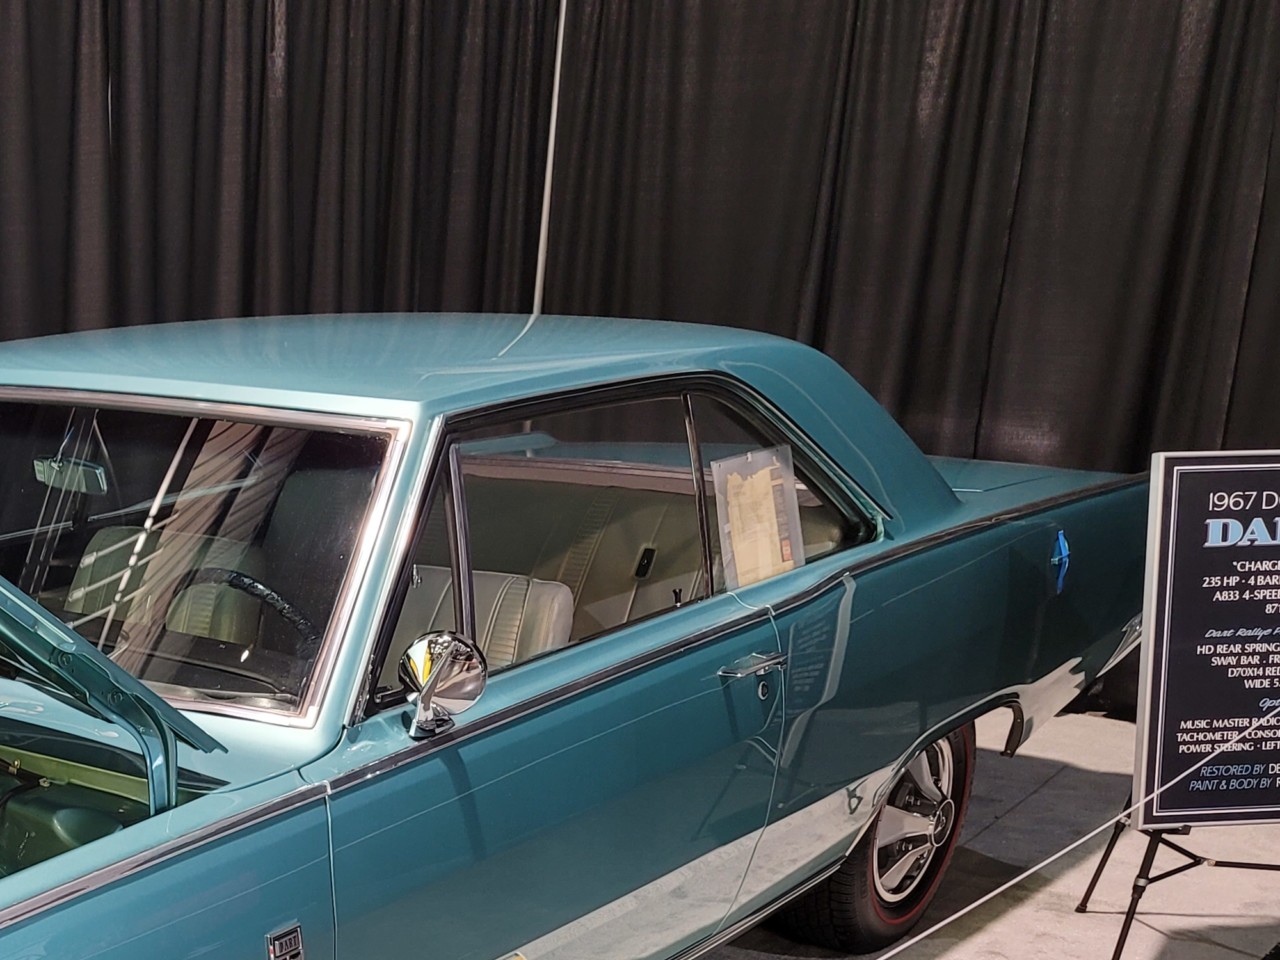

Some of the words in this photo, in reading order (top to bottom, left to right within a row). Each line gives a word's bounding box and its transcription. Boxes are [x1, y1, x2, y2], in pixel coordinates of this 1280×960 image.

[1208, 491, 1258, 511] 1967
[1261, 491, 1280, 510] D
[1202, 576, 1221, 588] 235
[1223, 575, 1240, 587] HP
[1247, 575, 1255, 586] 4
[1256, 575, 1280, 586] BAR
[1213, 590, 1239, 601] A833
[1205, 628, 1235, 639] Dart
[1235, 627, 1273, 640] Rallye
[1197, 645, 1214, 655] HD
[1216, 643, 1242, 654] REAR
[1211, 656, 1239, 666] SWAY
[1240, 655, 1260, 665] BAR
[1228, 667, 1263, 678] D70X14
[1244, 679, 1271, 689] WIDE
[1180, 719, 1211, 730] MUSIC
[1212, 718, 1250, 728] MASTER
[1176, 731, 1239, 742] TACHOMETER
[1179, 744, 1212, 753] POWER
[1200, 764, 1252, 777] RESTORED
[1252, 764, 1267, 775] BY
[1189, 779, 1220, 791] PAINT
[1219, 780, 1227, 790] &
[1228, 778, 1260, 790] BODY
[1259, 777, 1273, 788] BY
[278, 933, 298, 953] DART
